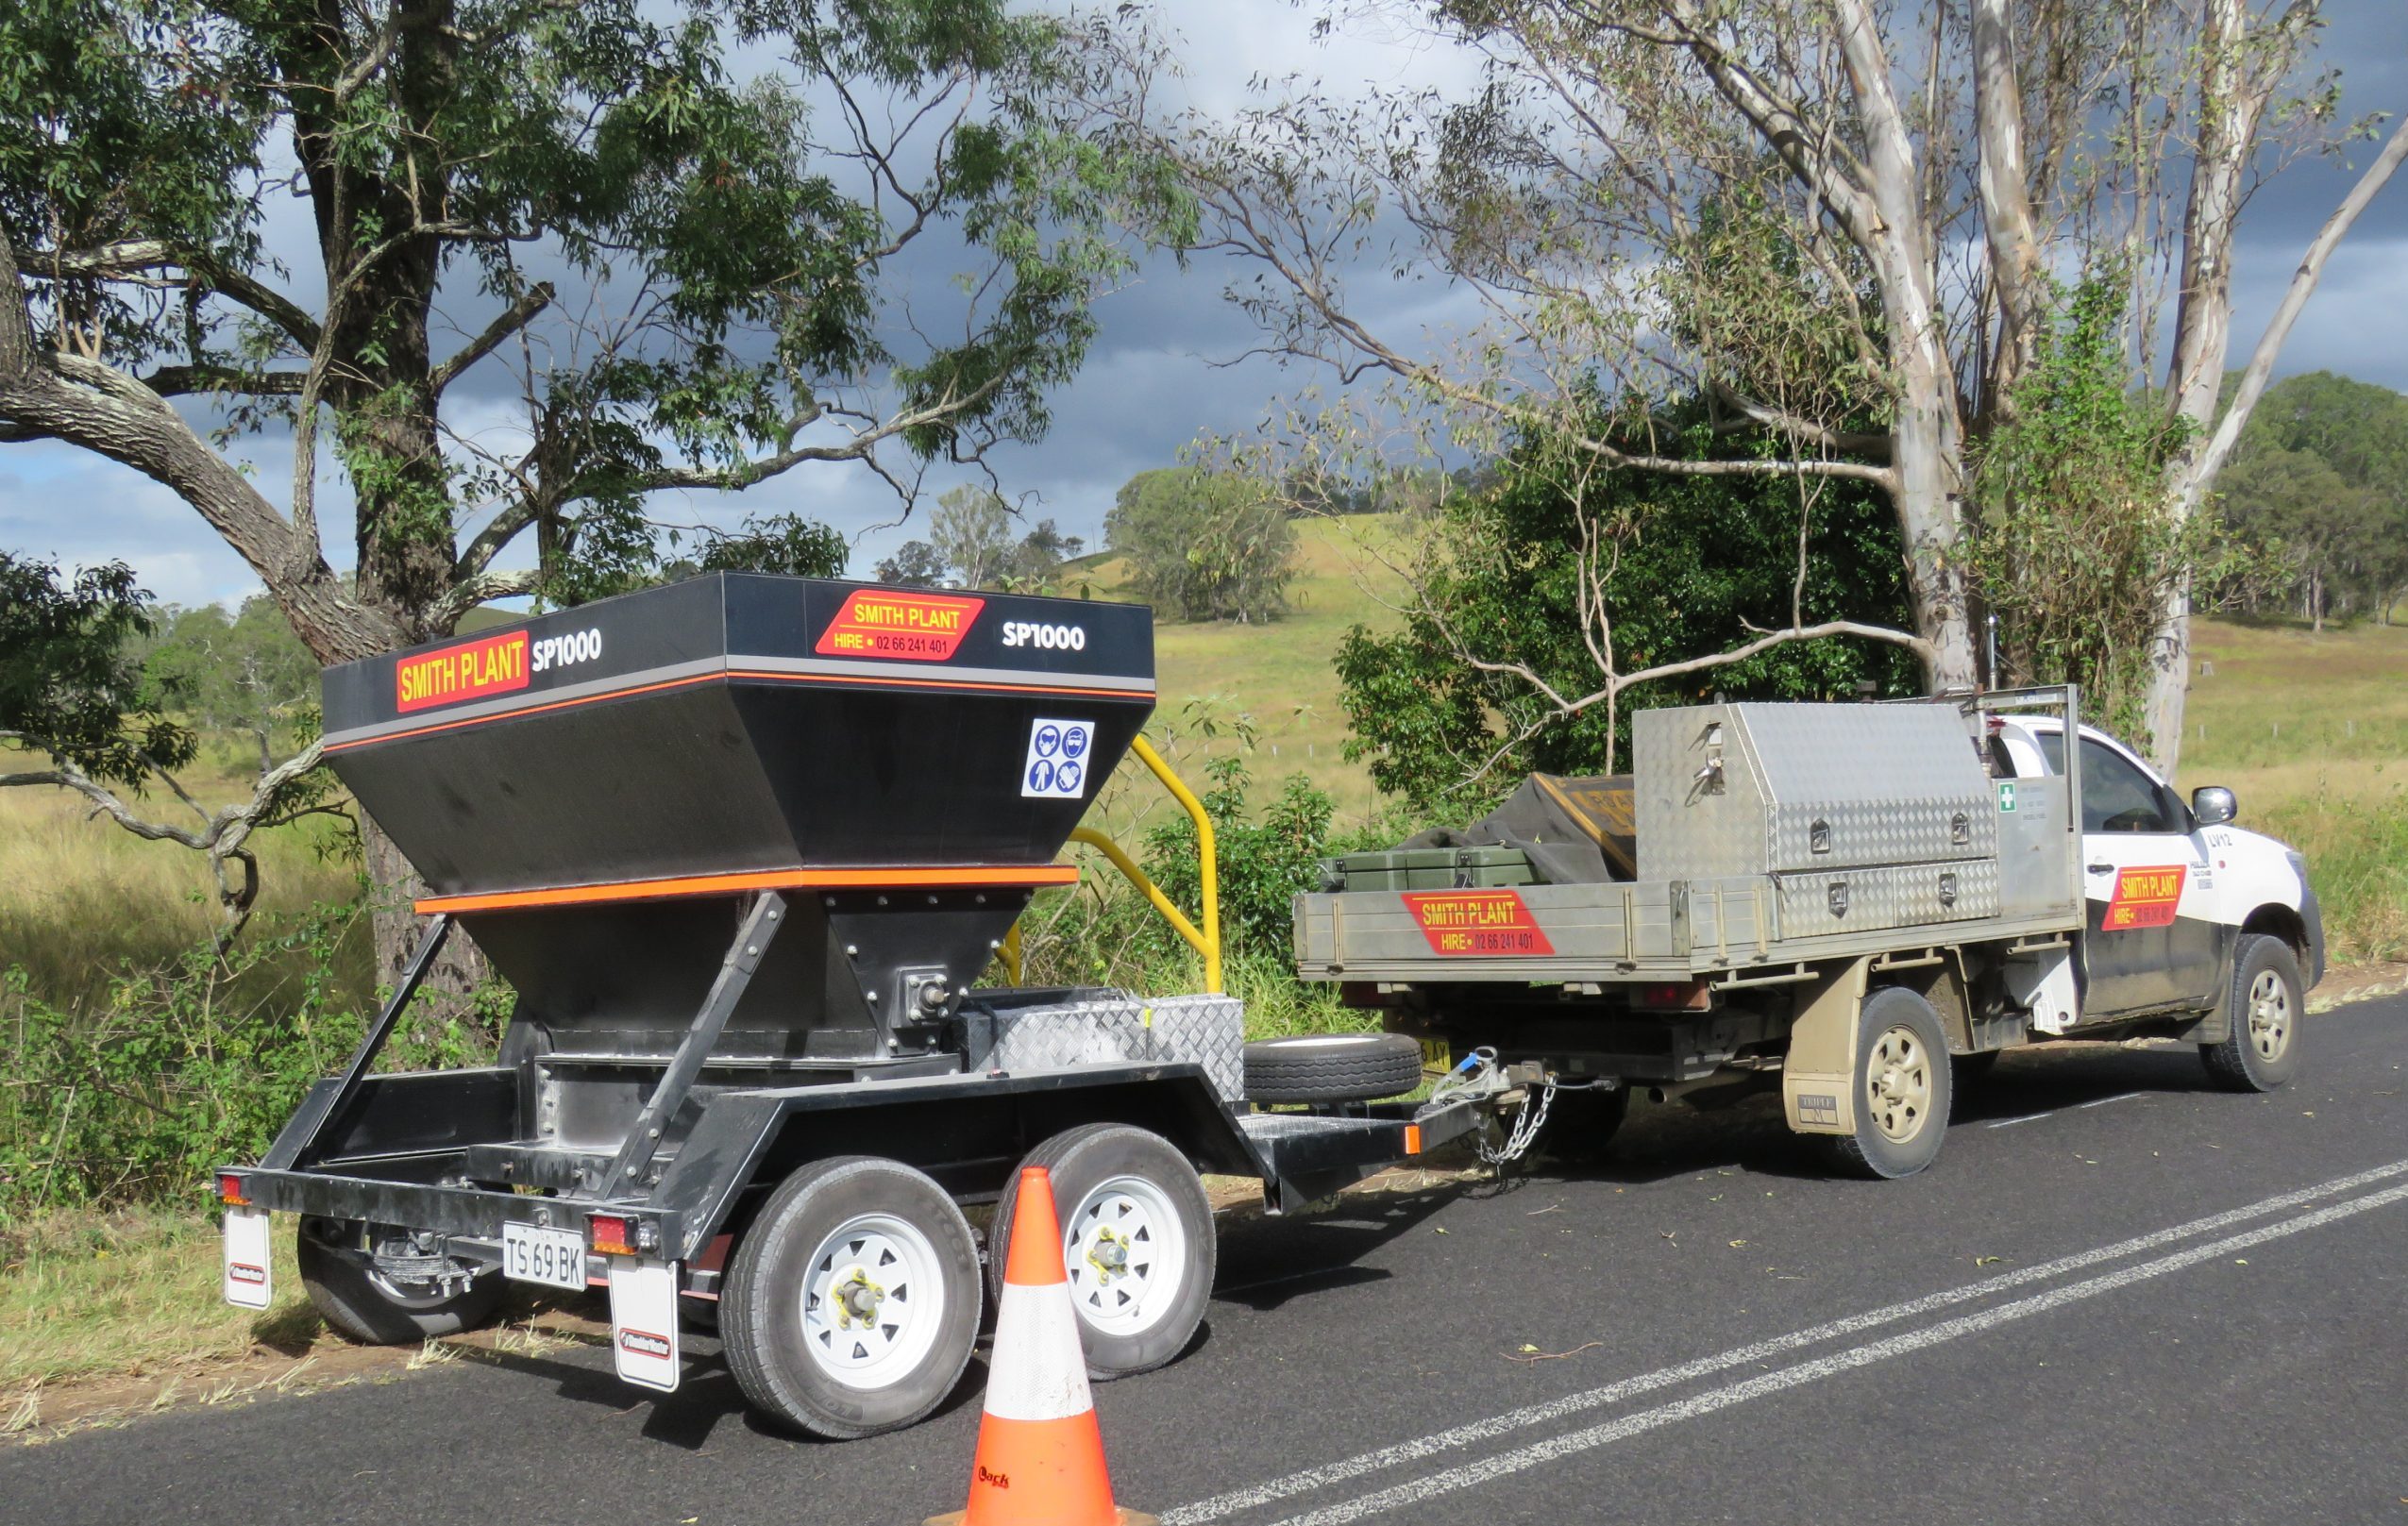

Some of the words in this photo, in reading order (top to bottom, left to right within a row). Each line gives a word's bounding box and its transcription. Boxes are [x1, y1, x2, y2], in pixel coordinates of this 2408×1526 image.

[854, 604, 904, 626] SMITH
[909, 609, 960, 629] PLANT
[834, 632, 864, 649] HIRE
[876, 636, 889, 650] 02
[893, 636, 905, 651] 66
[907, 637, 927, 652] 241
[929, 639, 947, 654] 401
[1002, 621, 1086, 651] SP1000
[531, 628, 602, 672] SP1000
[401, 656, 455, 702] SMITH
[461, 640, 524, 689] PLANT
[2208, 833, 2232, 847] LV12
[2121, 876, 2149, 898] SMITH
[2149, 875, 2178, 897] PLANT
[1422, 902, 1464, 926] SMITH
[1468, 901, 1515, 924] PLANT
[1441, 933, 1466, 950] HIRE
[1475, 933, 1486, 949] 02
[1488, 933, 1499, 949] 66
[1500, 933, 1516, 949] 241
[1518, 933, 1534, 949] 401
